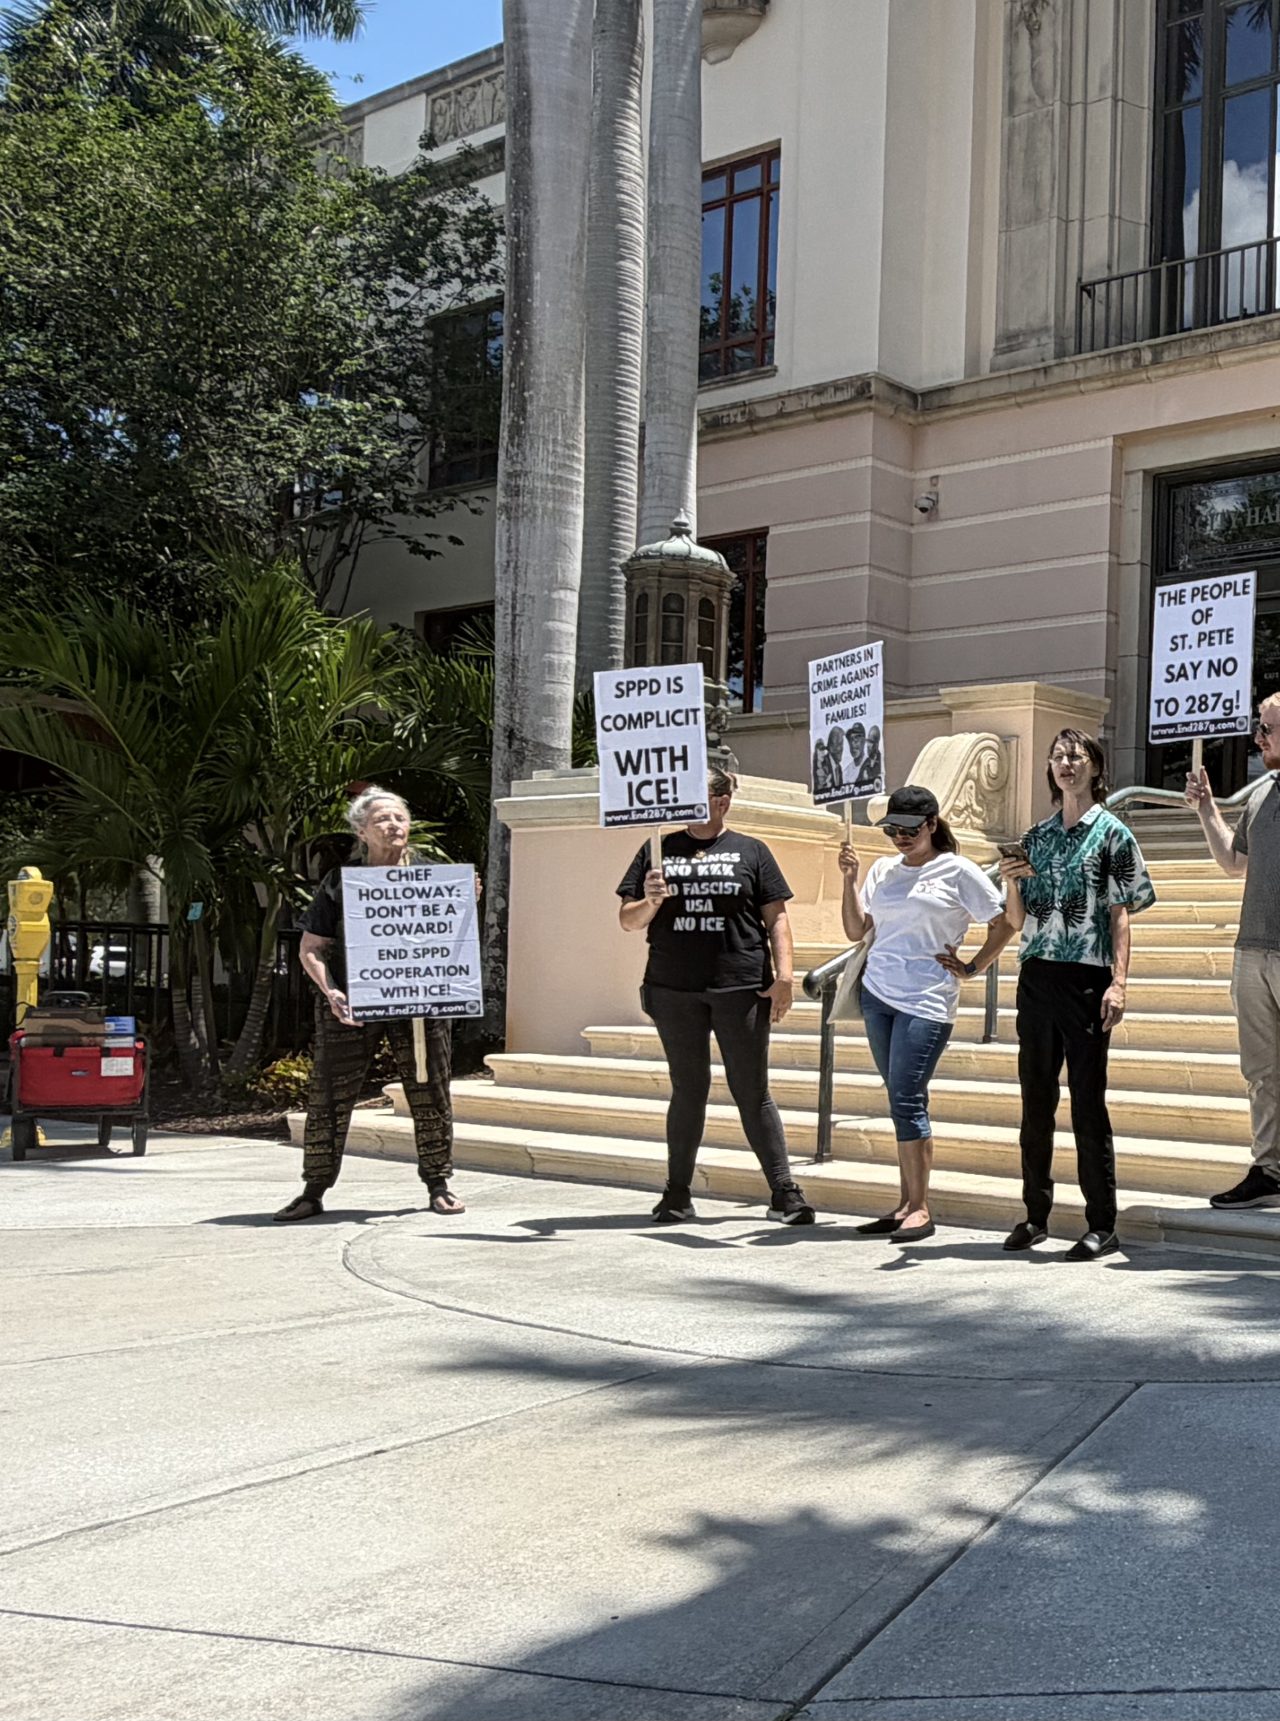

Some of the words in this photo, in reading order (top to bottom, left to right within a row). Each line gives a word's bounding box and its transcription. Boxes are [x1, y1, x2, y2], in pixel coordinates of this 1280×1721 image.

[1158, 589, 1186, 607] THE
[1191, 579, 1251, 603] PEOPLE
[1192, 607, 1213, 625] OF
[1170, 634, 1192, 652] ST.
[1198, 628, 1234, 648] PETE
[816, 653, 862, 676] PARTNERS
[864, 648, 873, 662] IN
[1164, 660, 1202, 683] SAY
[1208, 657, 1238, 678] NO
[811, 679, 838, 694] CRIME
[840, 663, 879, 686] AGAINST
[614, 679, 661, 699] SPPD
[667, 676, 683, 694] IS
[820, 684, 871, 709] IMMIGRANT
[1155, 698, 1179, 717] TO
[1185, 690, 1240, 716] 287g!
[601, 708, 700, 732] COMPLICIT
[826, 703, 866, 726] FAMILIES!
[1152, 721, 1235, 735] www.End287g.com
[614, 745, 688, 776] WITH
[627, 777, 679, 807] ICE!
[606, 809, 693, 822] www.End287g.com
[386, 869, 432, 882] CHIEF
[665, 865, 692, 877] NO
[698, 864, 735, 876] KKK
[359, 886, 461, 901] HOLLOWAY:
[682, 882, 742, 896] FASCIST
[422, 904, 441, 916] BE
[445, 903, 456, 915] A
[685, 899, 713, 912] USA
[371, 921, 453, 936] COWARD!
[673, 917, 696, 931] NO
[700, 917, 725, 931] ICE
[378, 949, 408, 960] END
[412, 947, 450, 959] SPPD
[360, 965, 469, 980] COOPERATION
[380, 986, 419, 998] WITH
[424, 984, 451, 996] ICE!
[354, 1003, 464, 1017] www.End287g.com
